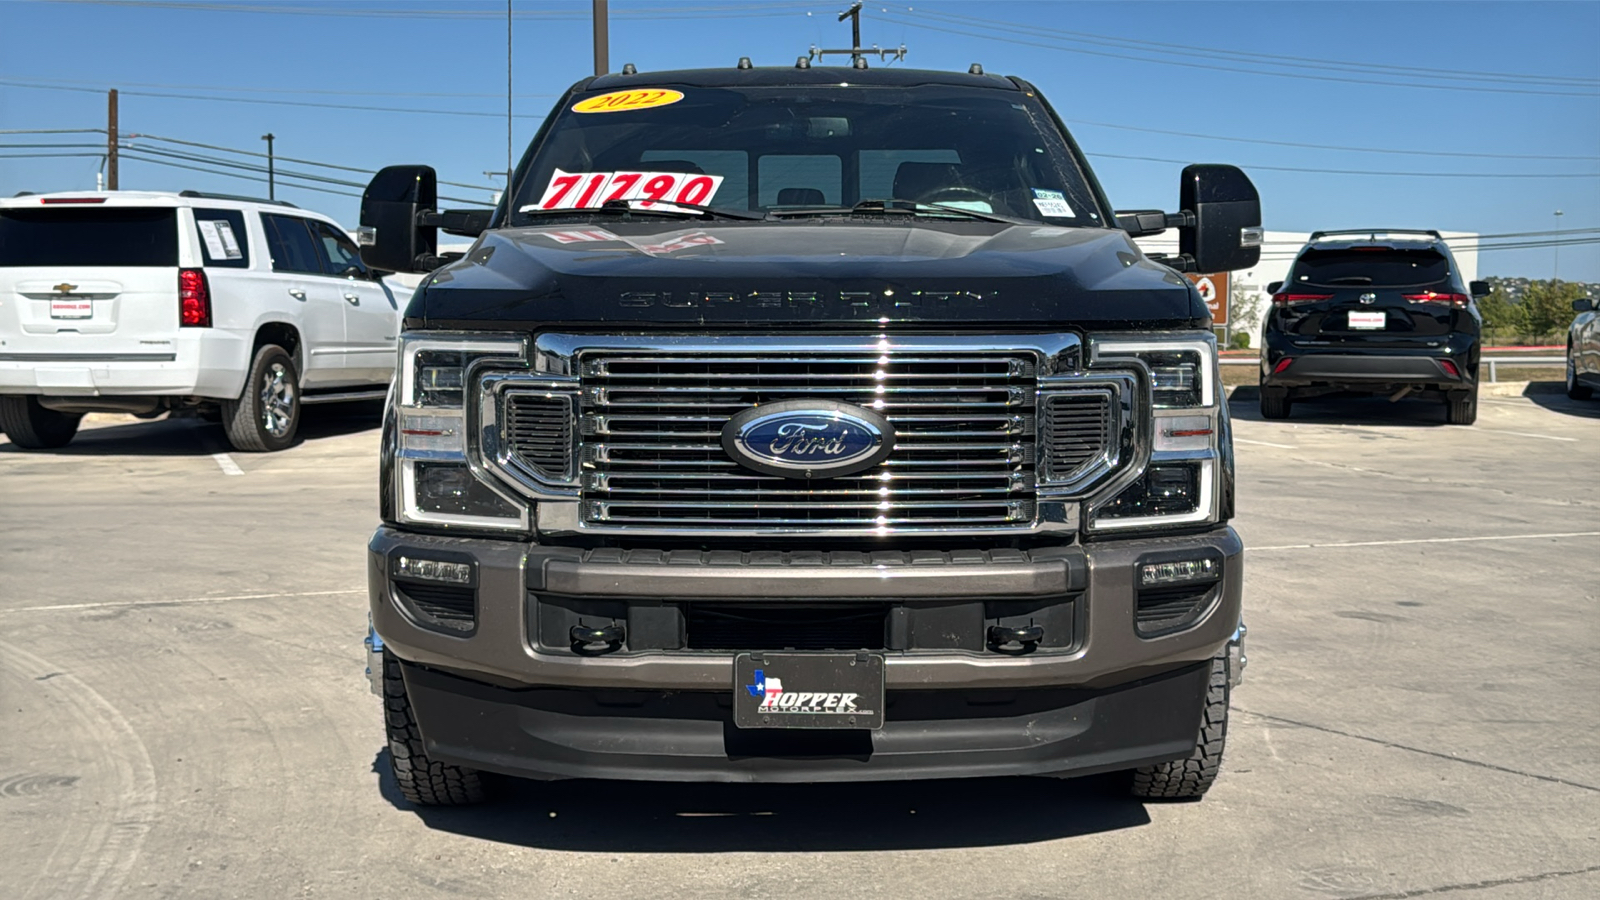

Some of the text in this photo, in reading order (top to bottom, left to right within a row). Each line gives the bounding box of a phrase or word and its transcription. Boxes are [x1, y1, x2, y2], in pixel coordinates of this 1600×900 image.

[588, 91, 666, 110] 2022
[542, 173, 715, 210] 71790
[618, 291, 999, 307] SUPER DUTY
[769, 422, 849, 455] Ford
[760, 692, 859, 707] HOPPER
